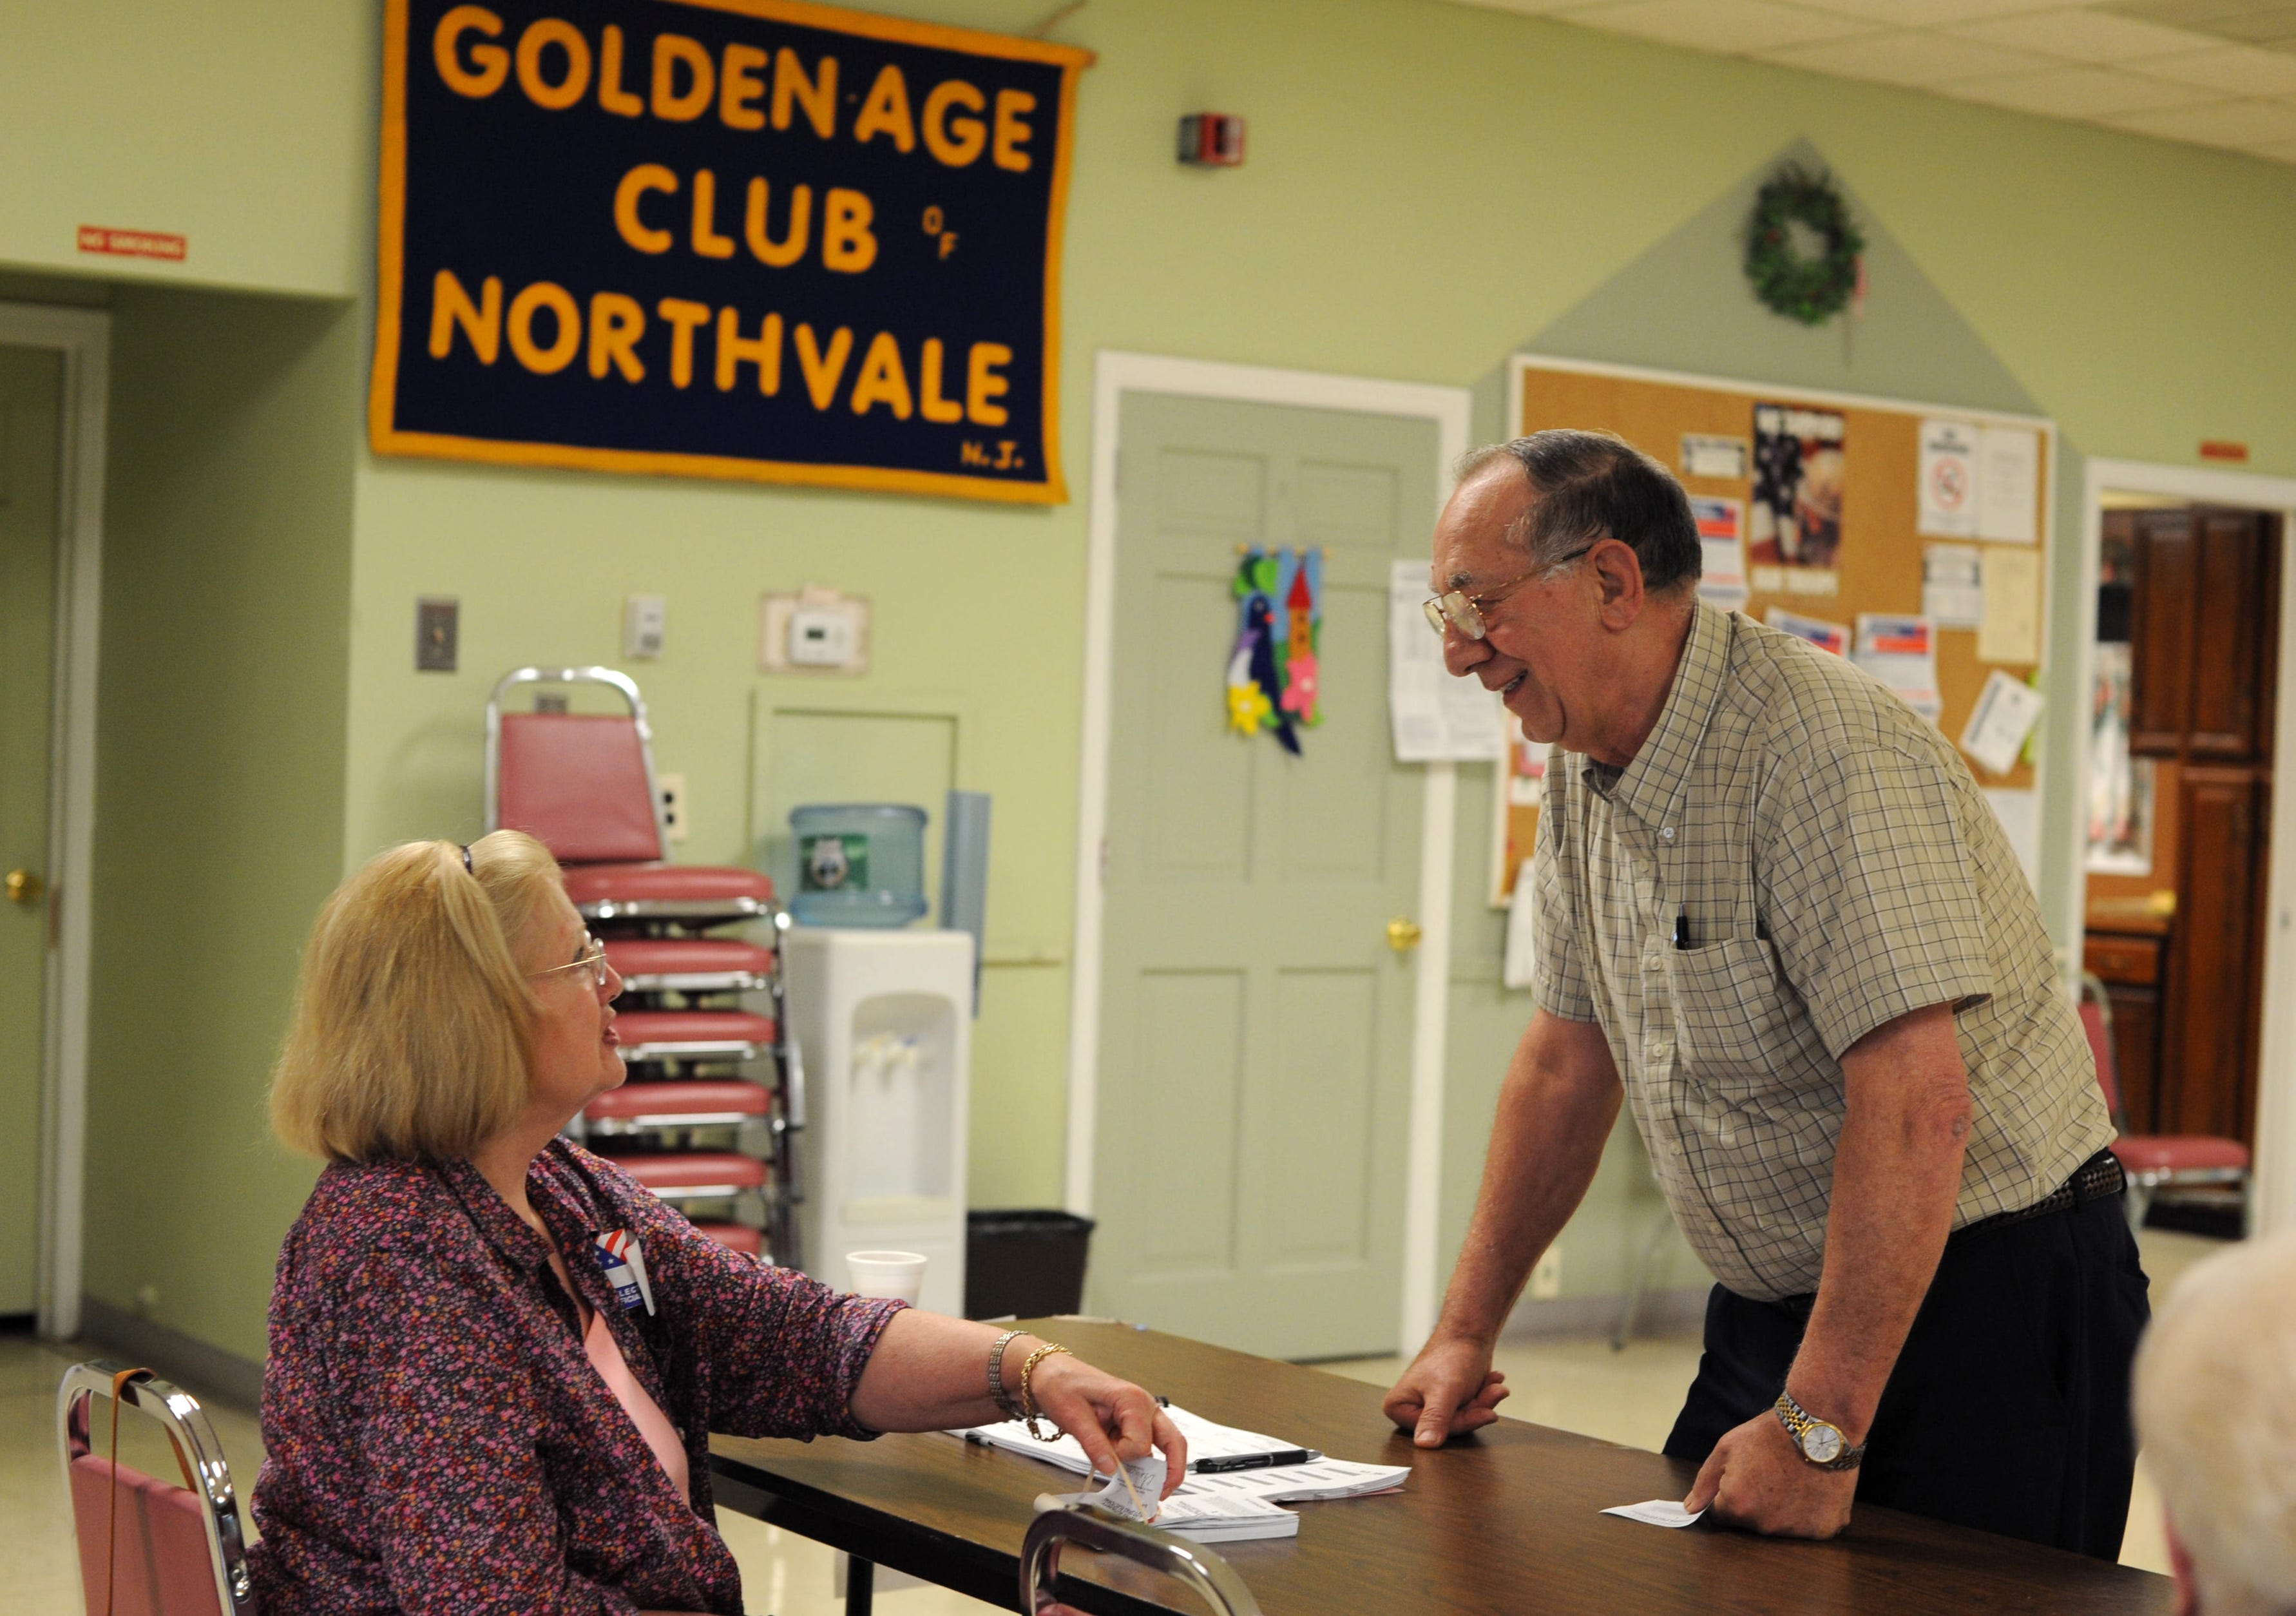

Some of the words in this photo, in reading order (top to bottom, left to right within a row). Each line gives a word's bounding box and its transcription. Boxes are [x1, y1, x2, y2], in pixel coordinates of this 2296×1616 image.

[433, 5, 839, 139] GOLDEN
[854, 64, 1037, 173] AGE
[613, 163, 878, 274] CLUB
[922, 206, 957, 258] OF
[429, 269, 1013, 427] NORTHVALE
[962, 441, 1024, 470] N.J.
